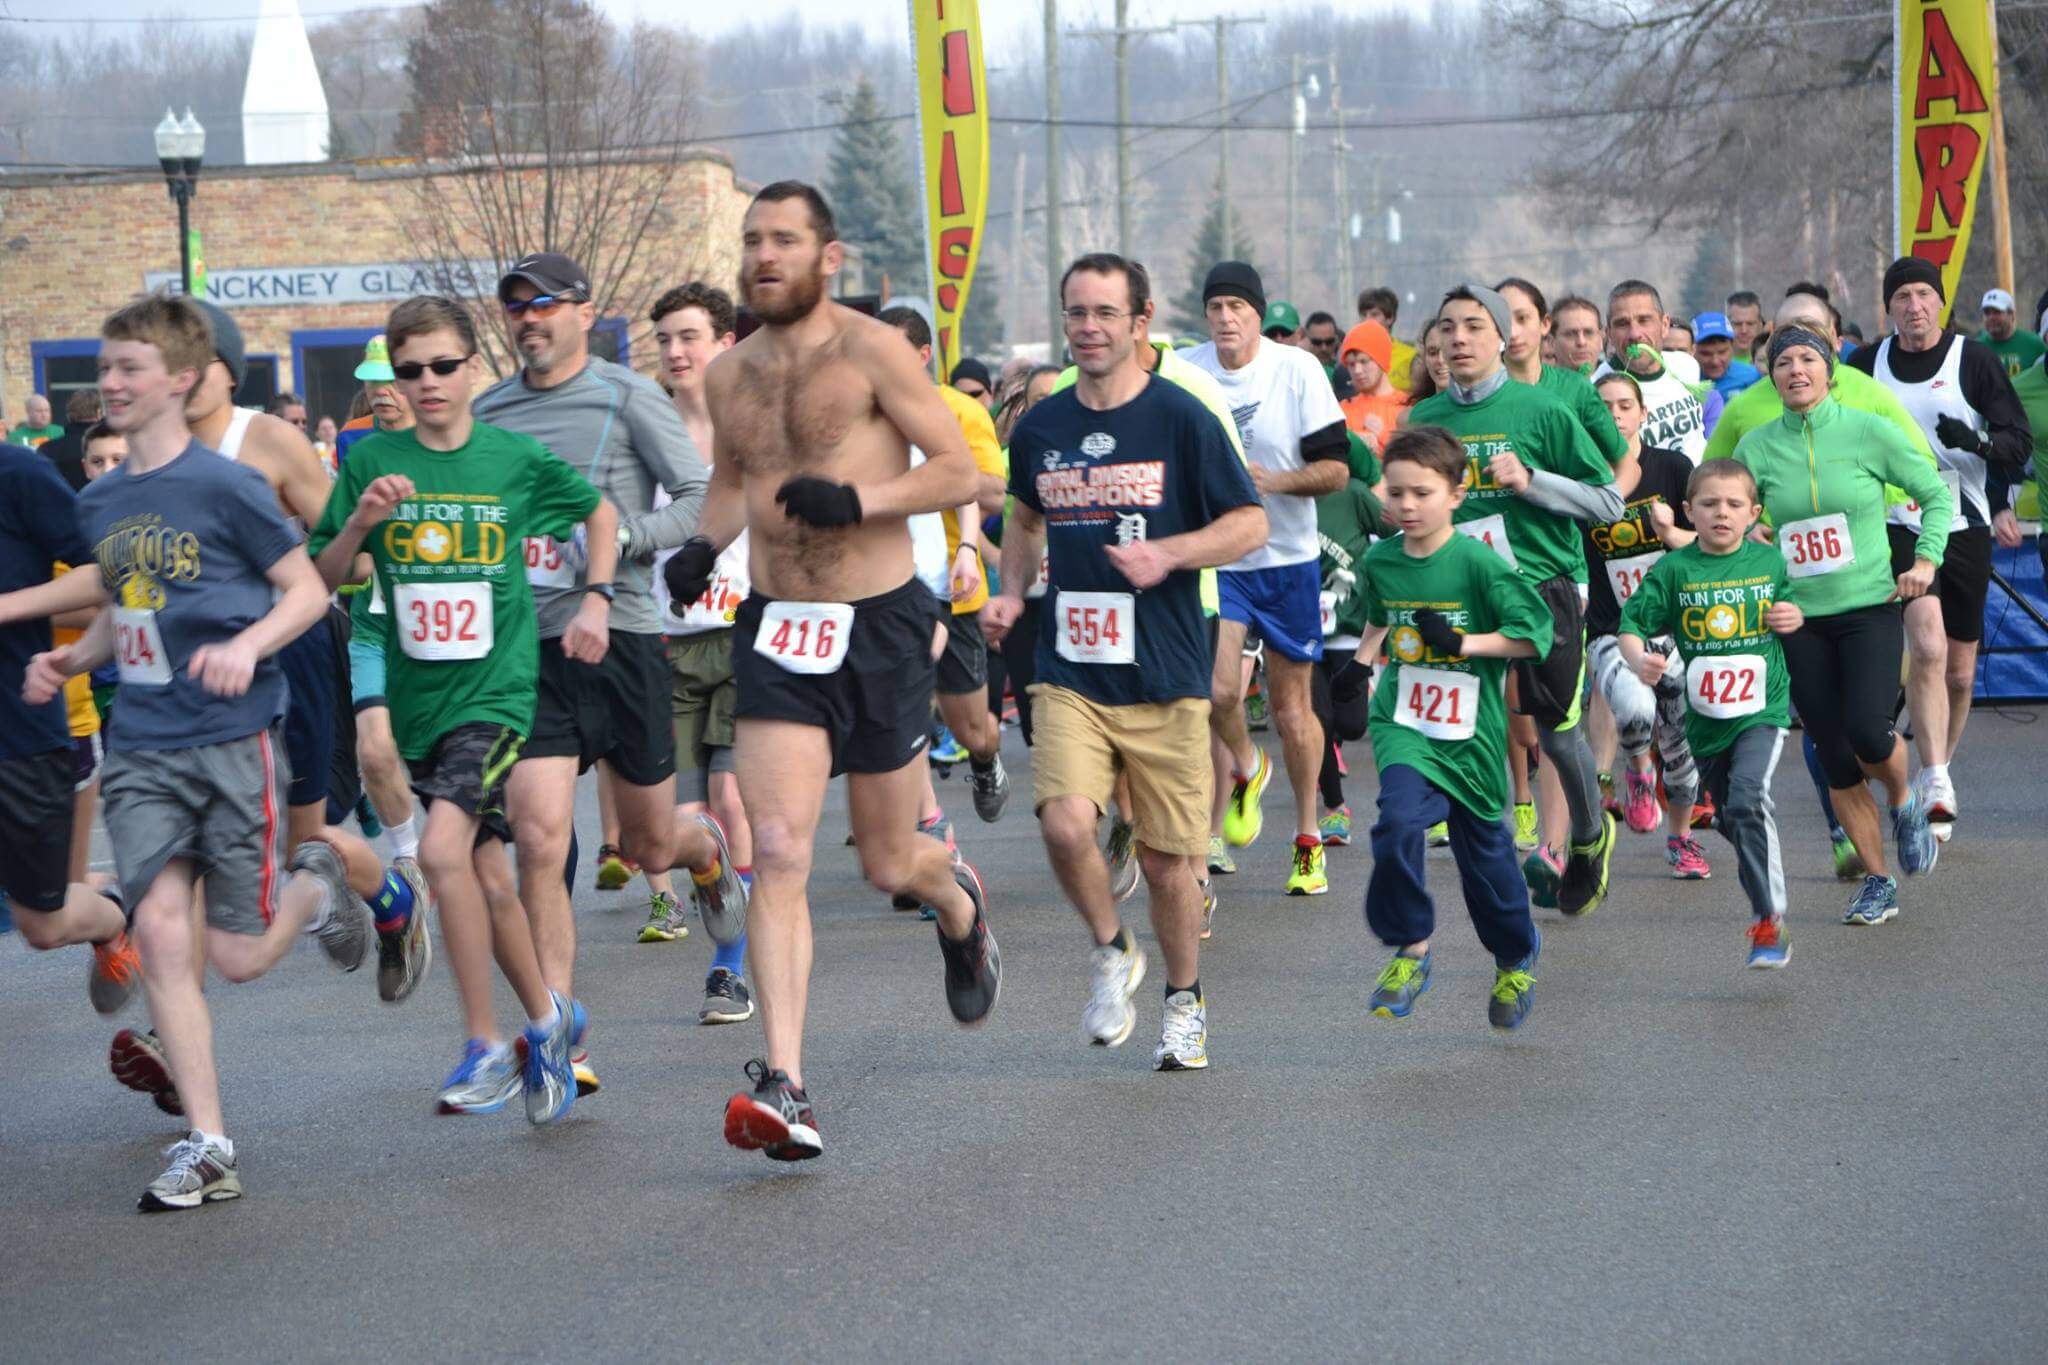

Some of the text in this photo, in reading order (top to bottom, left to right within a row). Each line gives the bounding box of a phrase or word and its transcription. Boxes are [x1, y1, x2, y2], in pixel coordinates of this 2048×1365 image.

[168, 272, 339, 300] PNCKNEY
[423, 504, 464, 521] FOR
[470, 505, 508, 523] THE
[384, 520, 506, 564] GOLD
[1790, 527, 1842, 564] 366
[687, 577, 729, 611] 47
[1679, 583, 1775, 607] RUN FOR THE
[411, 599, 478, 642] 392
[770, 618, 837, 659] 416
[1067, 607, 1121, 647] 554
[1409, 682, 1462, 724] 421
[1699, 668, 1755, 703] 422
